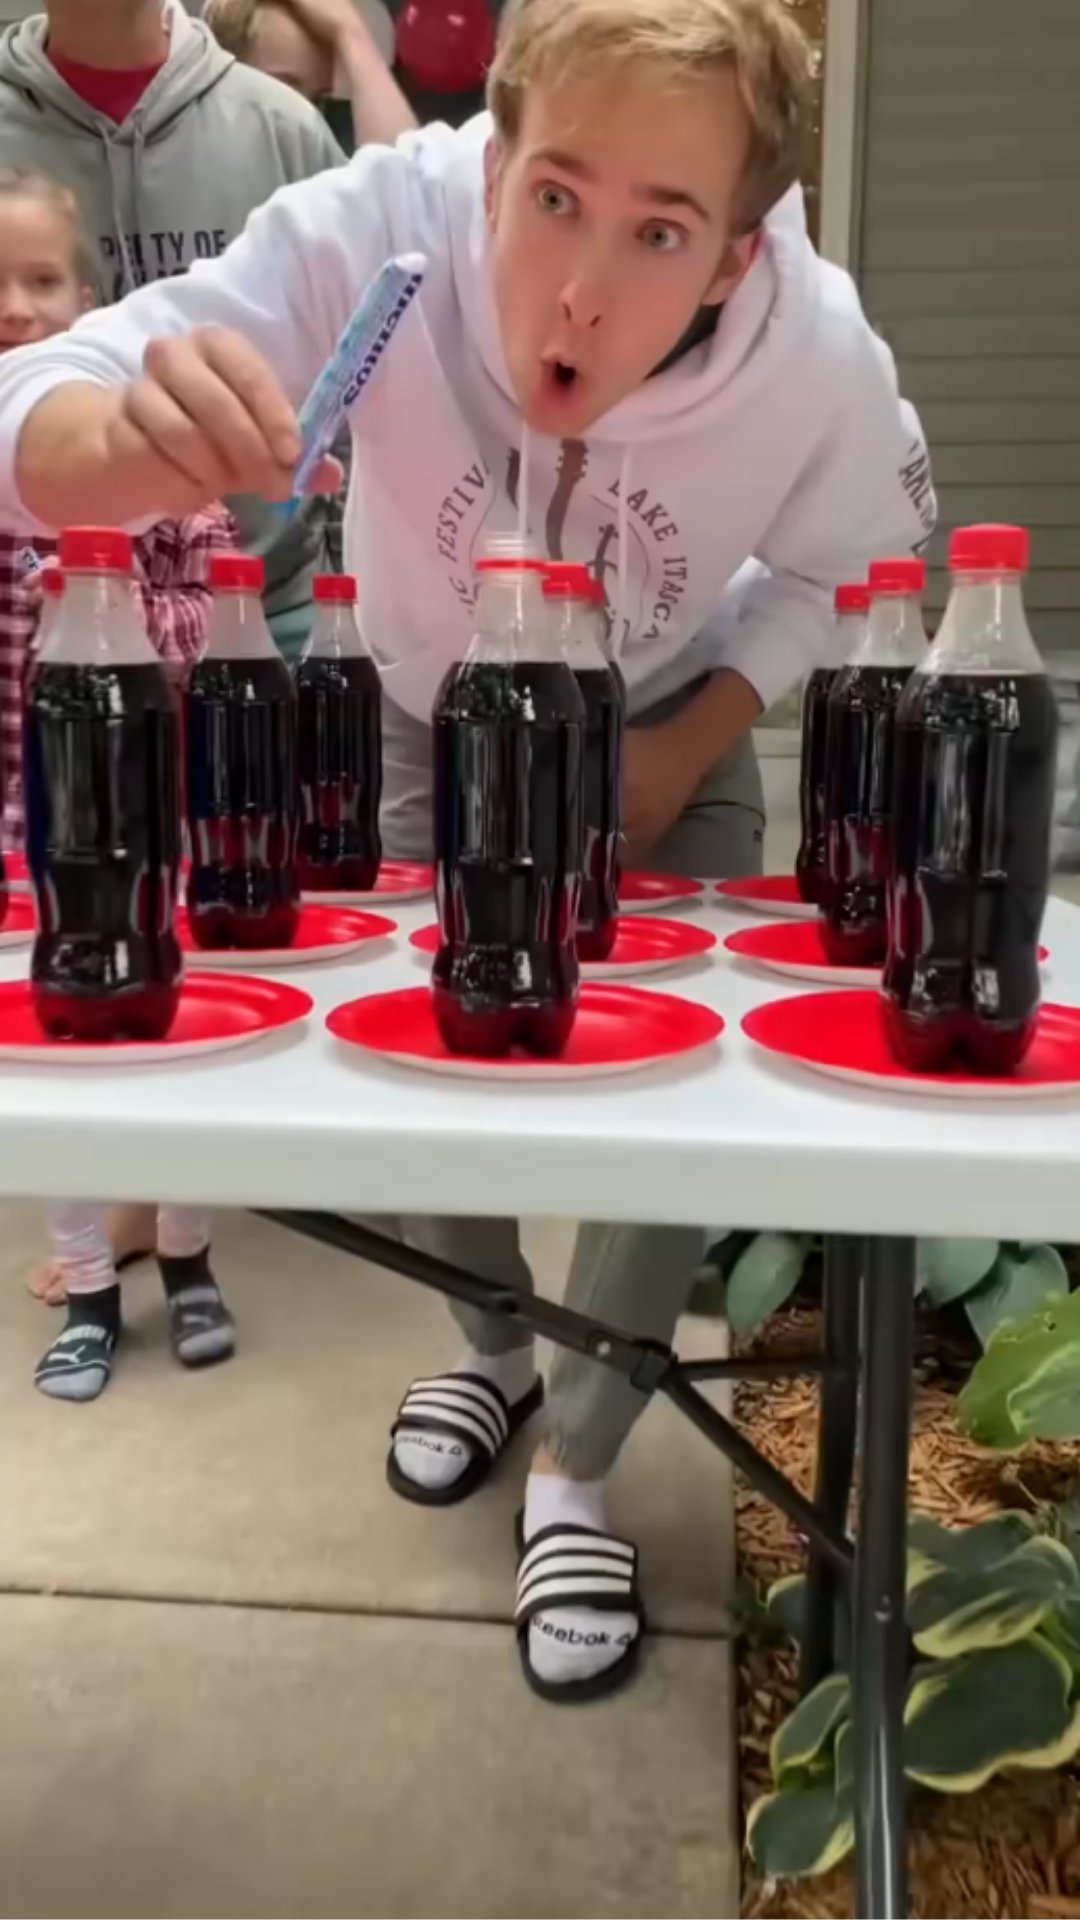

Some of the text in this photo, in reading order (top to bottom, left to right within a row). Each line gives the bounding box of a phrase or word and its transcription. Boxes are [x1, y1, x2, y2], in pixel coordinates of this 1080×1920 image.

[193, 228, 227, 260] OF
[606, 478, 688, 641] LAKE ITASCA
